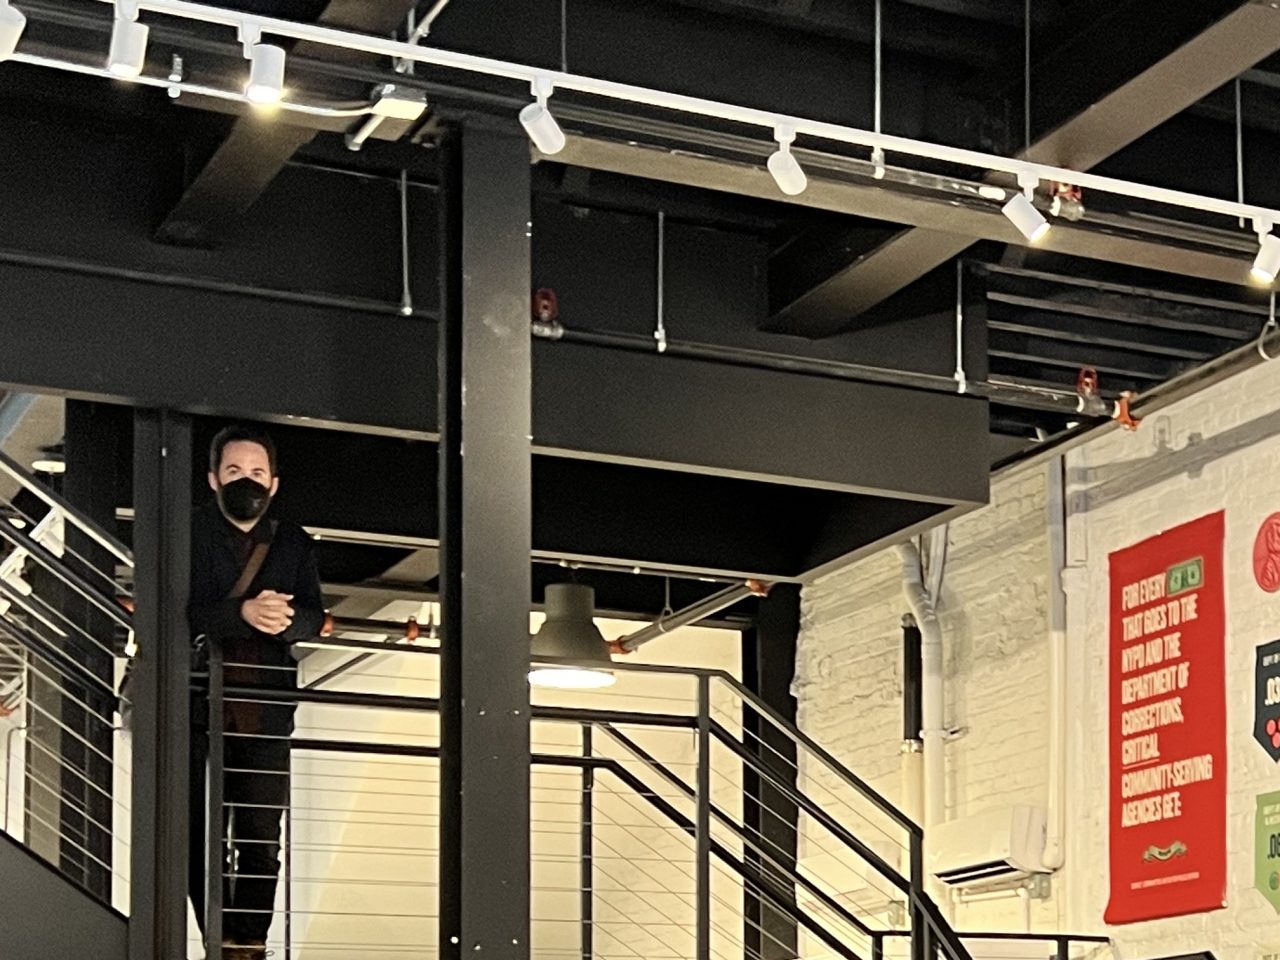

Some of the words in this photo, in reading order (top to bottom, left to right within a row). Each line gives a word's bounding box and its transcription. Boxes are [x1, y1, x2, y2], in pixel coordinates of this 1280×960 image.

[1144, 604, 1167, 635] GOES
[1167, 599, 1180, 627] TO
[1122, 665, 1177, 705] DEPARTMENT
[1177, 661, 1190, 689] OF
[1122, 732, 1160, 765] CRITICAL
